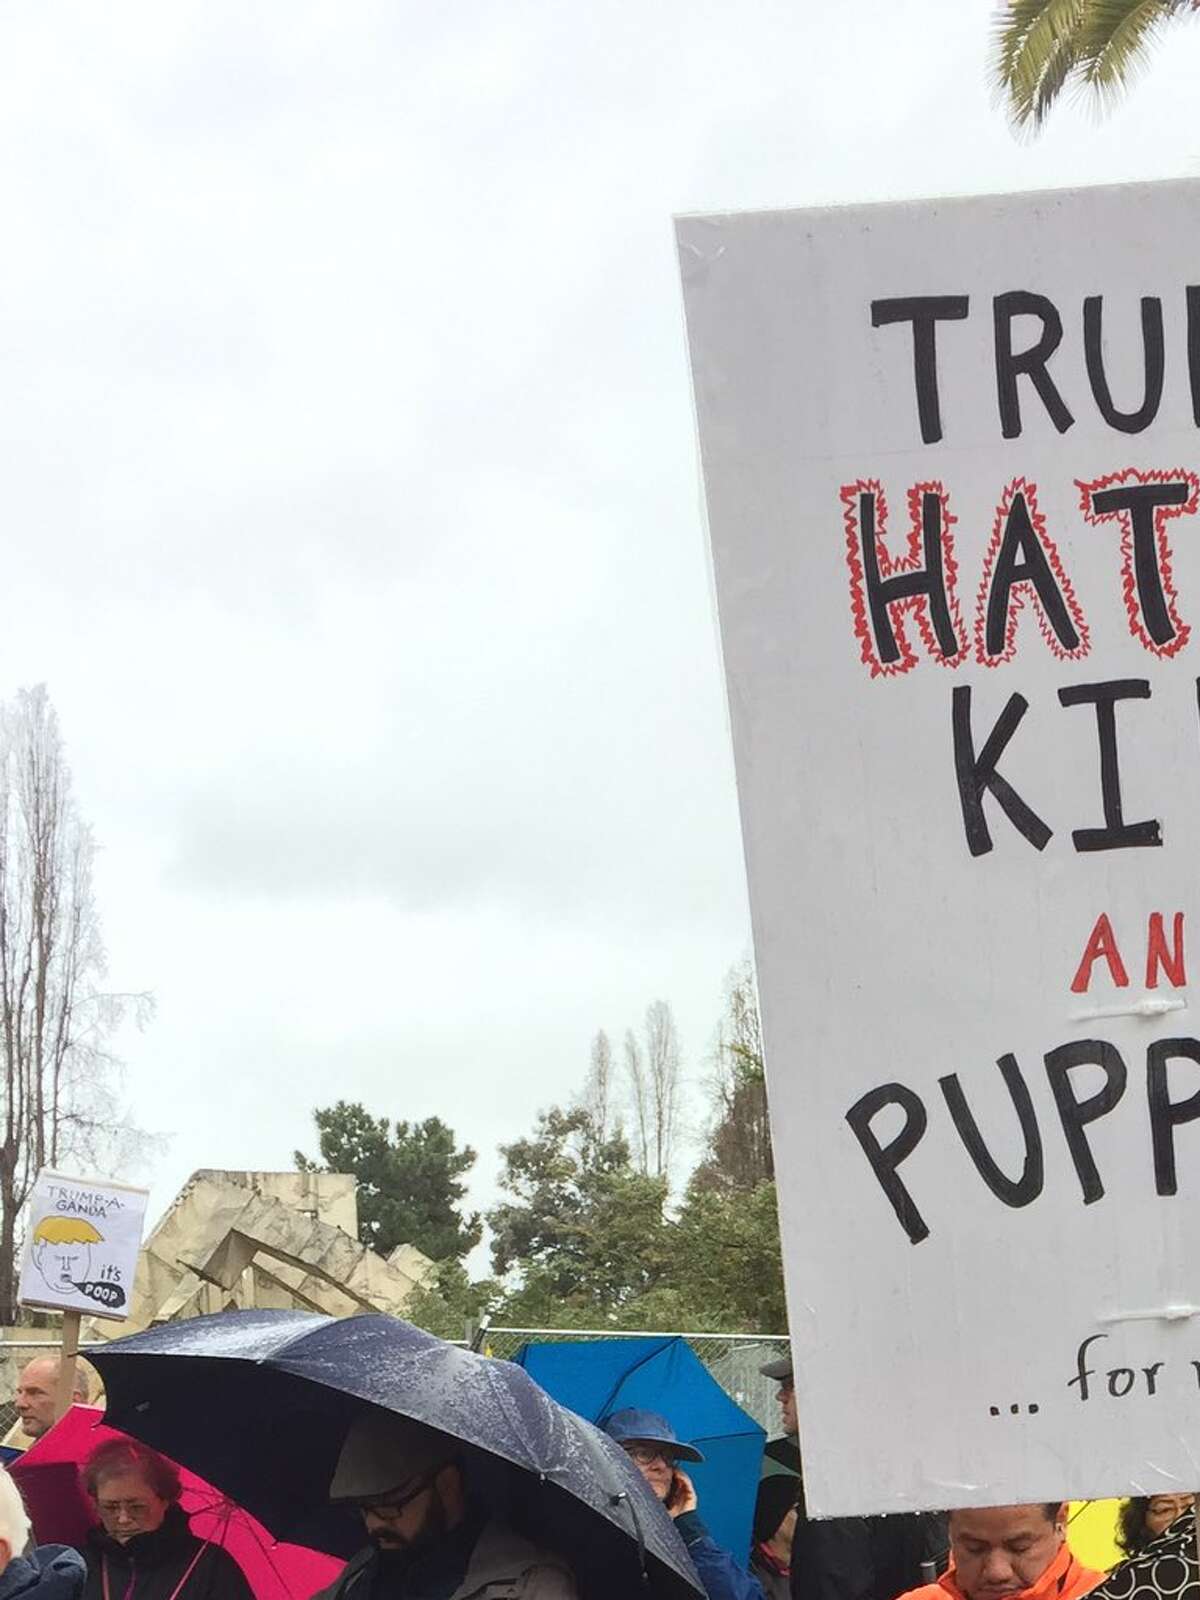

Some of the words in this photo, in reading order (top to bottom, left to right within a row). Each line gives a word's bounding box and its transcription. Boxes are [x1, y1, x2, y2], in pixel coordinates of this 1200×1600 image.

[56, 1200, 107, 1218] GANDA
[100, 1264, 121, 1281] it's
[85, 1284, 118, 1302] POOP
[1067, 1334, 1165, 1401] for
